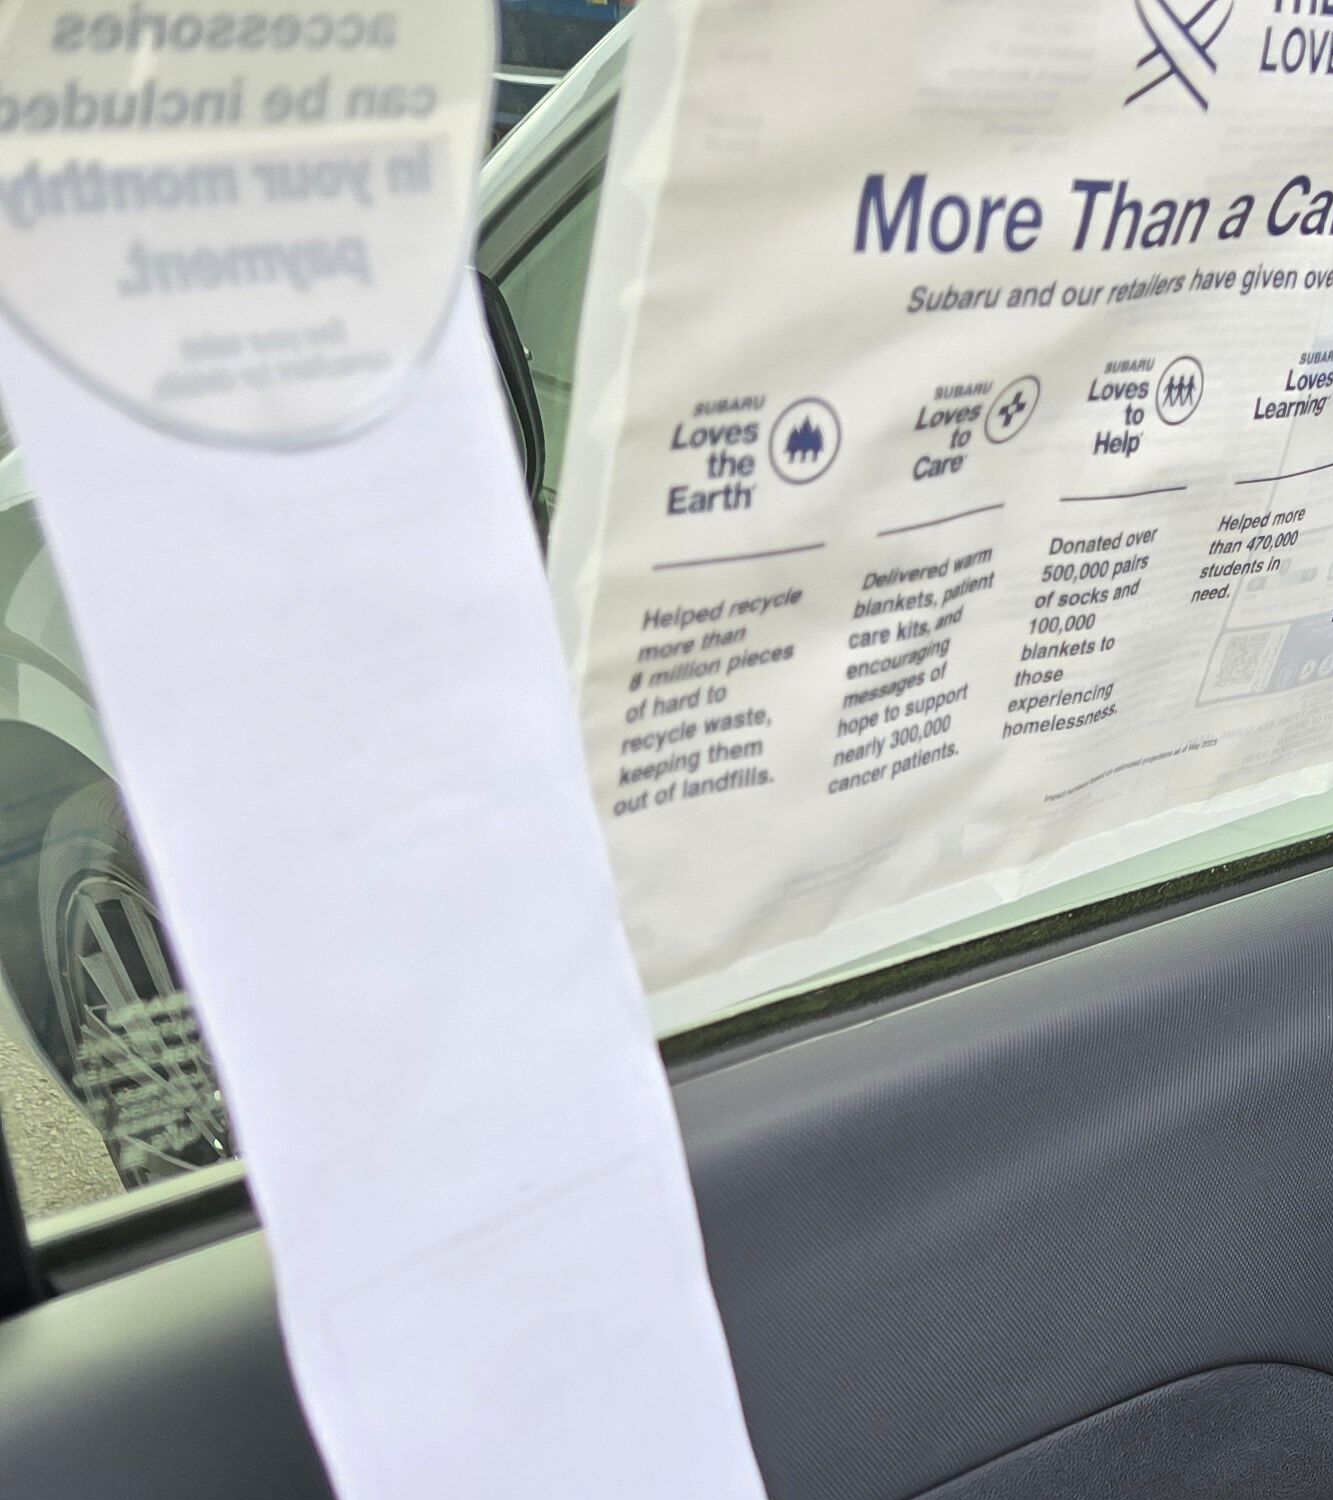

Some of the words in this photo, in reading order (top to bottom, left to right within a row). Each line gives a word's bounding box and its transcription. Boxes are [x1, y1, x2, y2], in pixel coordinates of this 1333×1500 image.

[854, 172, 1043, 254] More
[1070, 177, 1210, 251] Than
[1218, 198, 1252, 239] a
[907, 284, 999, 313] Subaru
[1007, 280, 1057, 307] and
[1061, 286, 1102, 307] our
[1107, 272, 1186, 303] retailers
[1189, 267, 1236, 292] have
[1240, 261, 1298, 295] given
[1103, 357, 1156, 375] SUBARU
[692, 393, 767, 418] SUBARU
[933, 381, 994, 401] SUBARU
[1087, 377, 1150, 403] Loves
[914, 401, 983, 431] Loves
[1124, 403, 1145, 426] to
[1253, 395, 1328, 421] Learning
[670, 422, 759, 450] Loves
[949, 427, 972, 450] to
[1092, 430, 1142, 459] Help
[707, 452, 755, 479] the
[912, 454, 964, 482] Care
[666, 481, 753, 515] Earth
[1217, 511, 1270, 533] Helped
[1272, 507, 1306, 526] more
[1048, 532, 1124, 556] Donated
[1125, 527, 1158, 548] over
[1208, 539, 1242, 557] than
[1245, 531, 1299, 553] 470,000
[861, 559, 950, 591] Delivered
[953, 548, 993, 573] warm
[1041, 560, 1110, 584] 500,000
[1111, 554, 1150, 580] pairs
[1199, 559, 1264, 580] students
[1266, 556, 1281, 572] in
[853, 592, 937, 619] blankets,
[942, 571, 995, 605] patient
[1034, 590, 1056, 609] of
[1058, 587, 1109, 607] socks
[1112, 577, 1141, 601] and
[1190, 584, 1231, 603] need.
[642, 600, 724, 631] Helped
[728, 587, 803, 618] recycle
[1029, 613, 1096, 636] 100,000
[848, 629, 890, 650] care
[896, 621, 930, 641] kits,
[935, 605, 964, 631] and
[637, 639, 695, 663] more
[701, 627, 747, 650] than
[846, 637, 951, 681] encouraging
[1020, 639, 1096, 662] blankets
[1099, 636, 1116, 652] to
[648, 658, 721, 688] million
[726, 643, 795, 676] pieces
[1014, 668, 1064, 688] those
[843, 672, 925, 709] messages
[930, 661, 948, 682] of
[1007, 680, 1115, 714] experiencing
[625, 699, 647, 724] of
[652, 685, 701, 717] hard
[706, 684, 727, 704] to
[837, 711, 879, 738] hope
[884, 704, 900, 723] to
[905, 683, 969, 717] support
[621, 721, 697, 755] recycle
[704, 707, 772, 734] waste,
[1001, 702, 1118, 739] homelessness.
[833, 735, 886, 768] nearly
[890, 714, 952, 750] 300,000
[618, 750, 700, 786] keeping
[708, 739, 763, 763] them
[828, 764, 887, 795] cancer
[891, 740, 960, 780] patients.
[613, 792, 648, 817] out
[654, 782, 677, 806] of
[683, 767, 775, 799] landfills.
